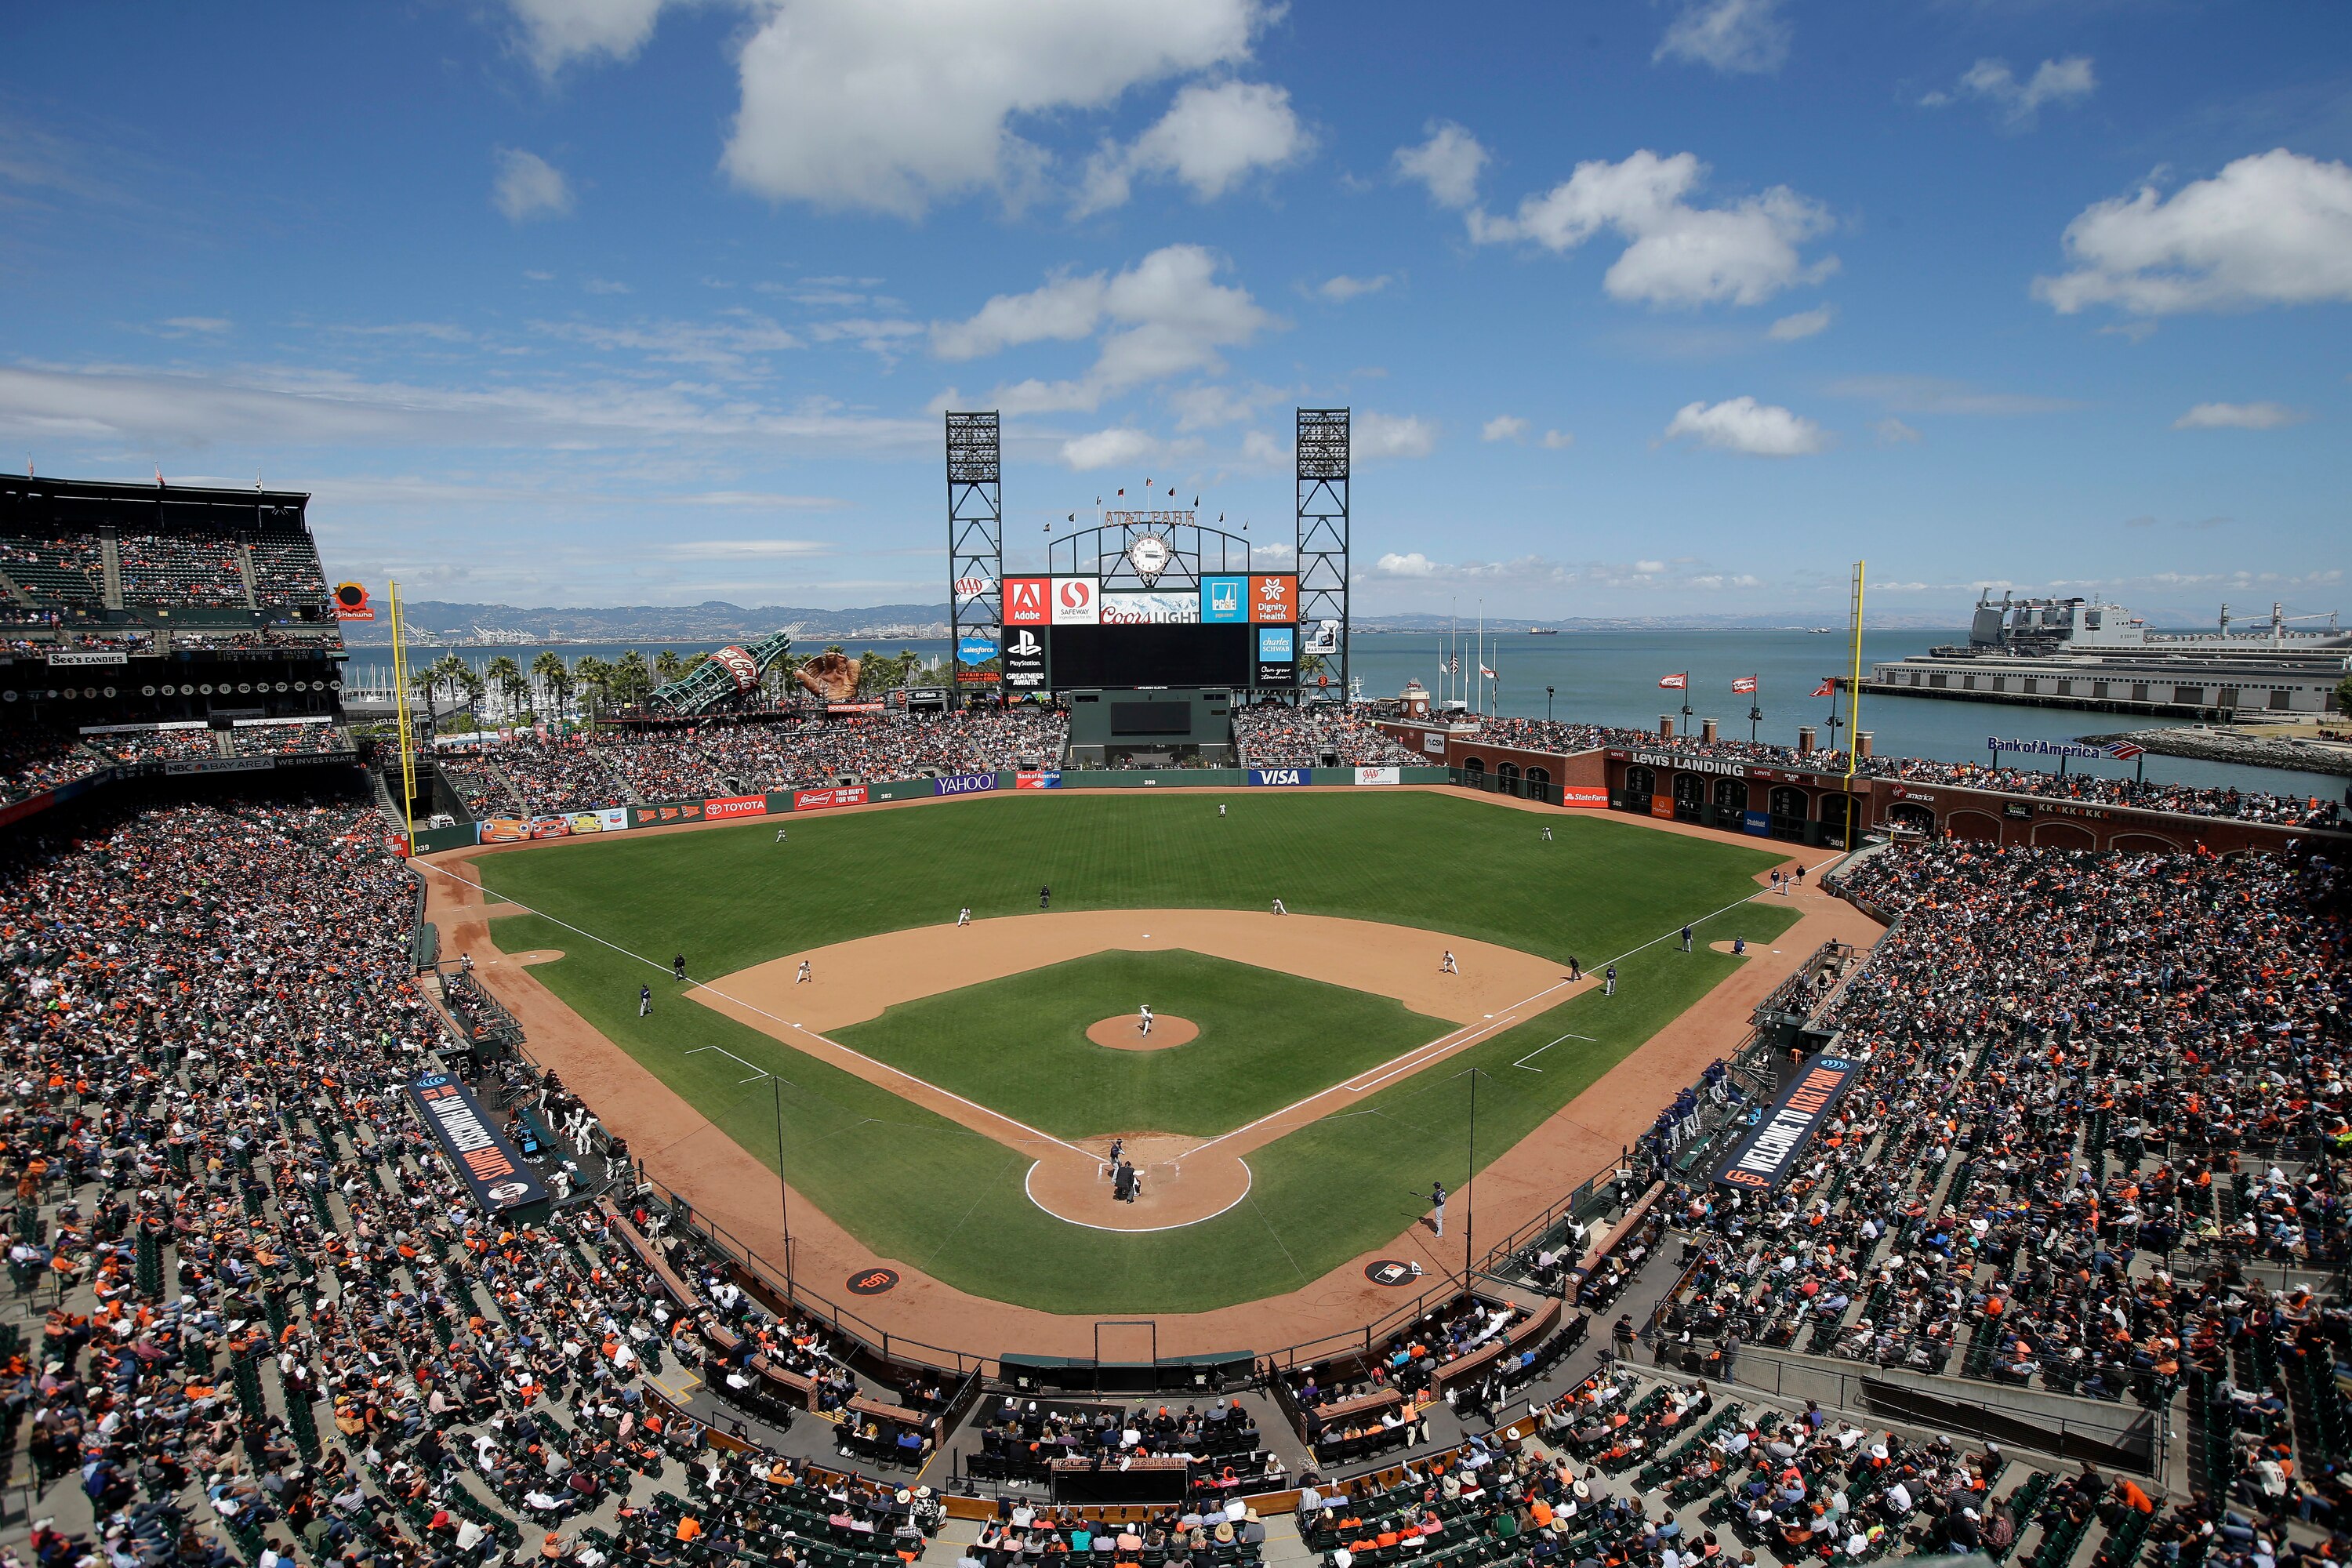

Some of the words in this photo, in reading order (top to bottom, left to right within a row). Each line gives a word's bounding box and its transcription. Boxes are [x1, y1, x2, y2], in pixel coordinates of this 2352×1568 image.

[1104, 511, 1144, 528] AT&T
[1149, 511, 1196, 527] PARK
[1134, 530, 1174, 558] FRANCISCO
[1134, 568, 1167, 580] GIANTS
[959, 580, 979, 592] AAA
[1214, 599, 1235, 609] PG&E
[1014, 610, 1040, 620] Adobe
[1101, 606, 1152, 624] Coors
[1154, 612, 1200, 624] LIGHT
[1262, 637, 1289, 646] charles
[52, 655, 82, 664] See's
[1987, 736, 2023, 751] Bank
[2023, 740, 2039, 753] of
[2038, 740, 2101, 759] America
[168, 764, 193, 772] NBC
[238, 760, 271, 768] AREA
[296, 754, 356, 764] INVESTIGATE
[1364, 769, 1378, 778] AAA
[1674, 757, 1744, 777] LANDING
[938, 773, 996, 794] YAHOO!
[1258, 770, 1300, 784] VISA
[801, 794, 829, 803] Budweiser
[1905, 792, 1935, 801] america
[724, 800, 764, 812] TOYOTA
[1747, 818, 1766, 828] StubHub!
[1802, 1067, 1846, 1091] PARK
[428, 1095, 468, 1118] SAN
[1786, 1087, 1830, 1113] AT&T
[1775, 1109, 1814, 1124] TO
[439, 1109, 494, 1152] FRANCISCO
[1737, 1121, 1805, 1173] WELCOME
[463, 1146, 515, 1181] GIANTS
[489, 1179, 521, 1205] GIANTS
